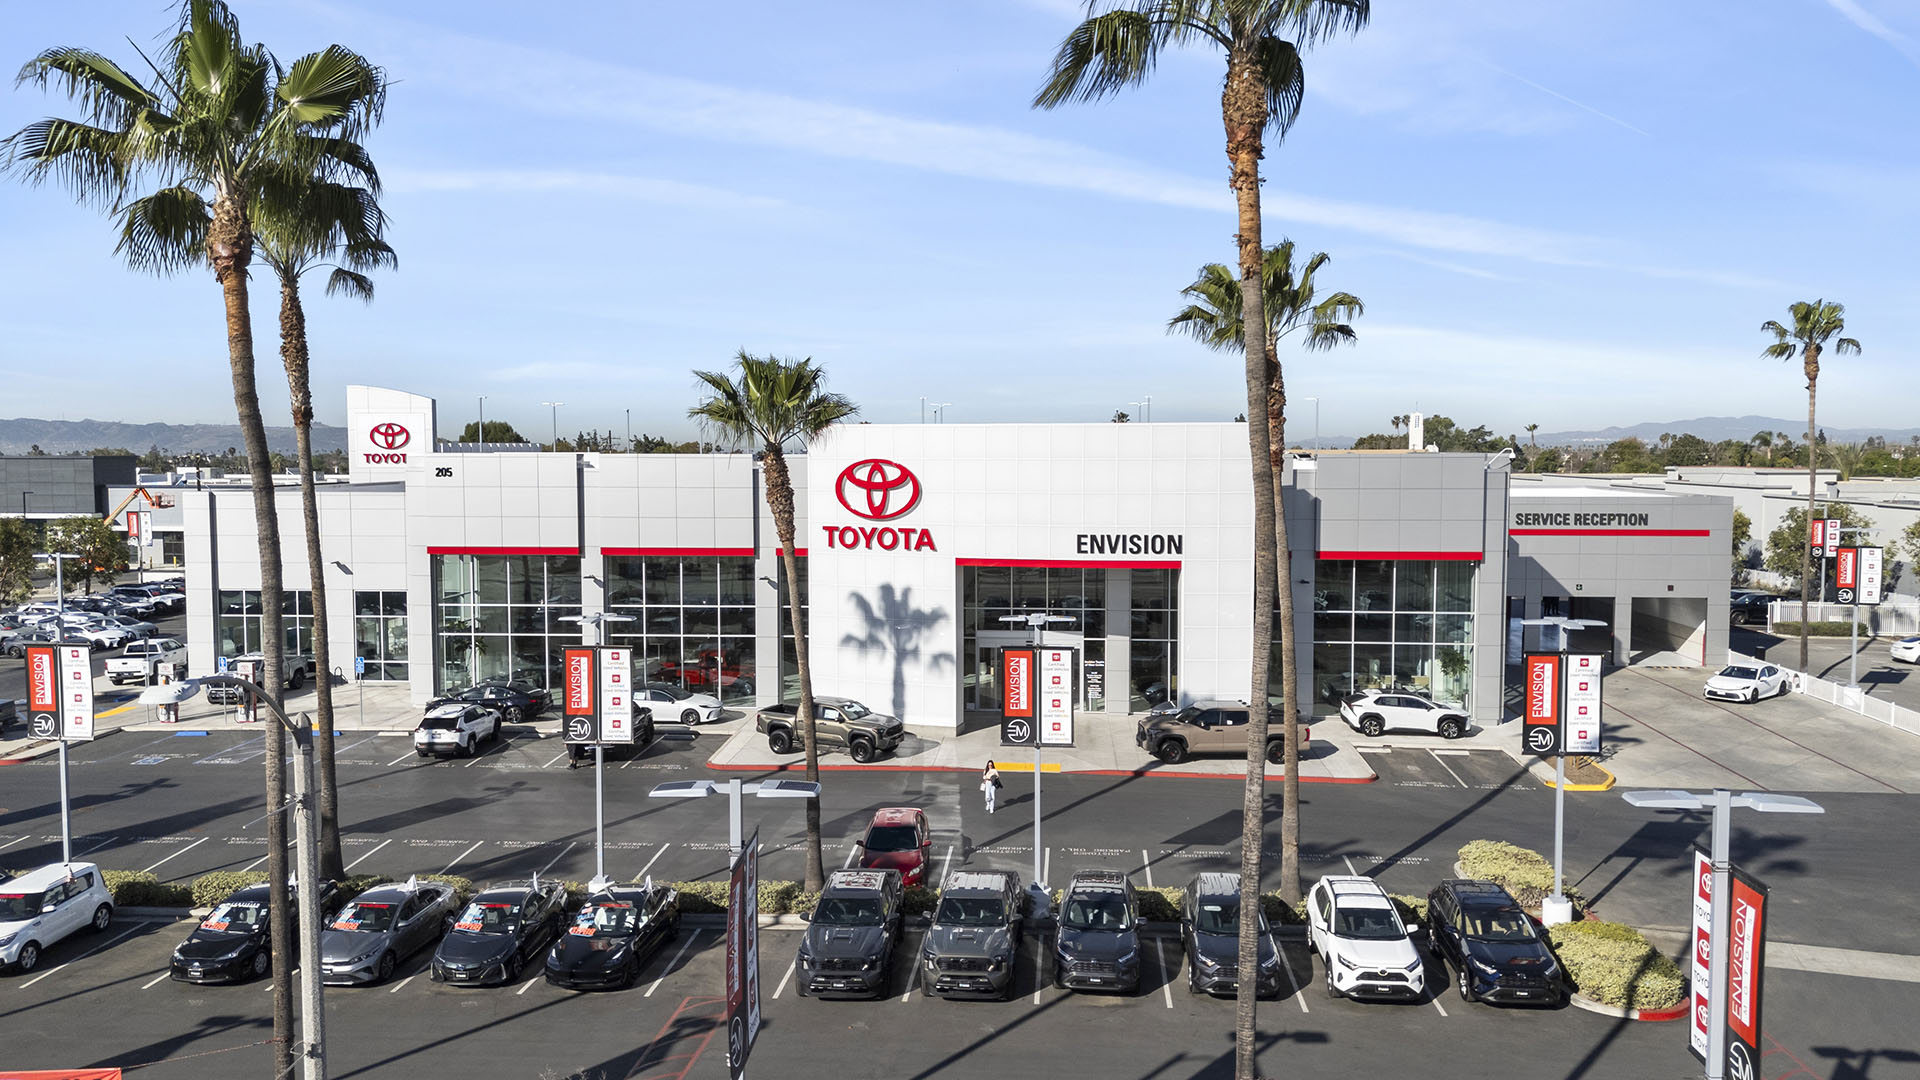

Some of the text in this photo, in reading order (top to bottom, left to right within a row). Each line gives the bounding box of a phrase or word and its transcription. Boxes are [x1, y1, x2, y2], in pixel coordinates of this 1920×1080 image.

[363, 453, 407, 464] TOYOT
[435, 467, 453, 477] 205
[1515, 513, 1649, 526] SERVICE RECEPTION
[822, 526, 937, 552] TOYOTA
[1076, 534, 1183, 555] ENVISION
[1839, 552, 1848, 584] ENVISION
[33, 653, 46, 705] ENVISION
[571, 656, 581, 709] ENVISION
[1009, 657, 1020, 710] ENVISION
[1532, 662, 1544, 718] ENVISION
[1696, 904, 1711, 922] TOYO
[1732, 897, 1748, 1020] ENVISION
[1743, 917, 1753, 1016] MOTORS
[1694, 969, 1709, 989] TOYO
